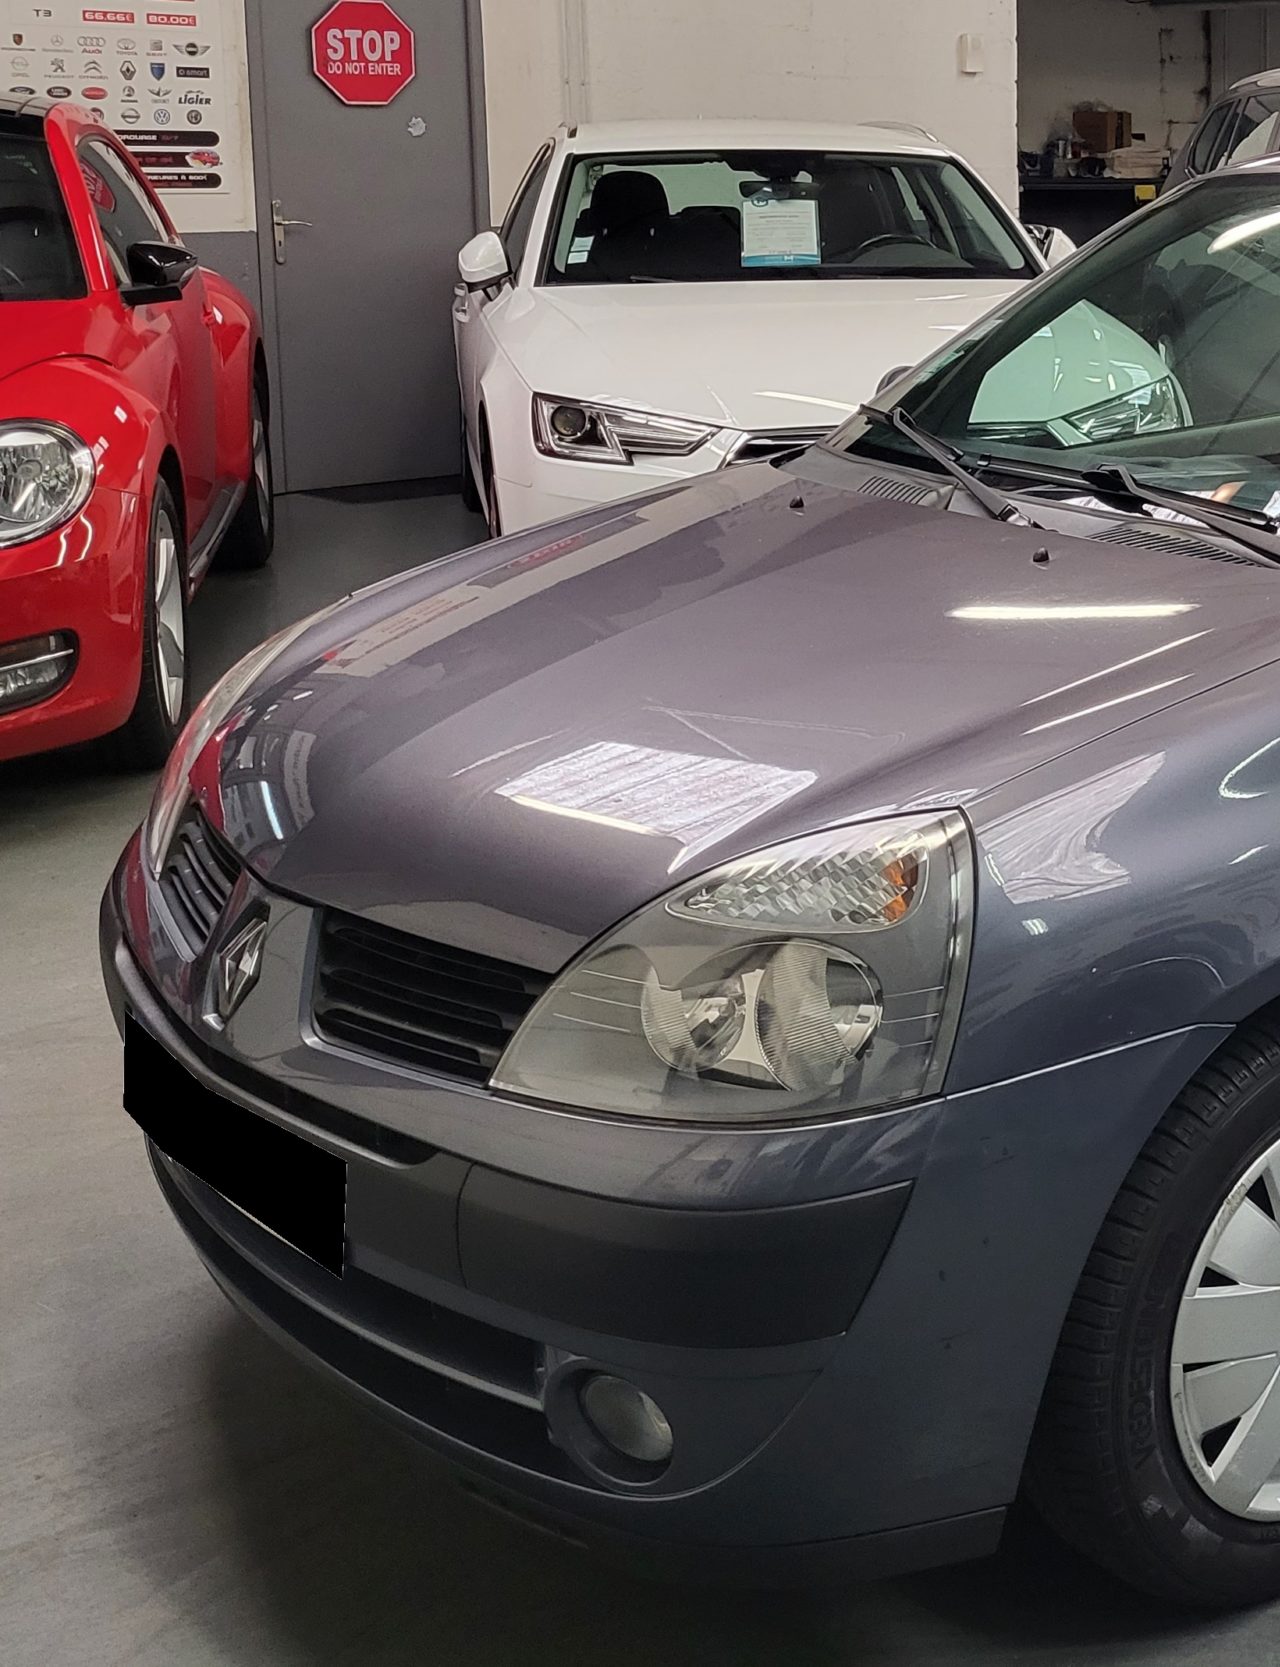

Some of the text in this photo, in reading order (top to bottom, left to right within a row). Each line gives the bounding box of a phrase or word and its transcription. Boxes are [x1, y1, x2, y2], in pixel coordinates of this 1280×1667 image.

[32, 8, 53, 18] T3
[327, 28, 400, 61] STOP
[328, 62, 402, 76] DO NOT ENTER
